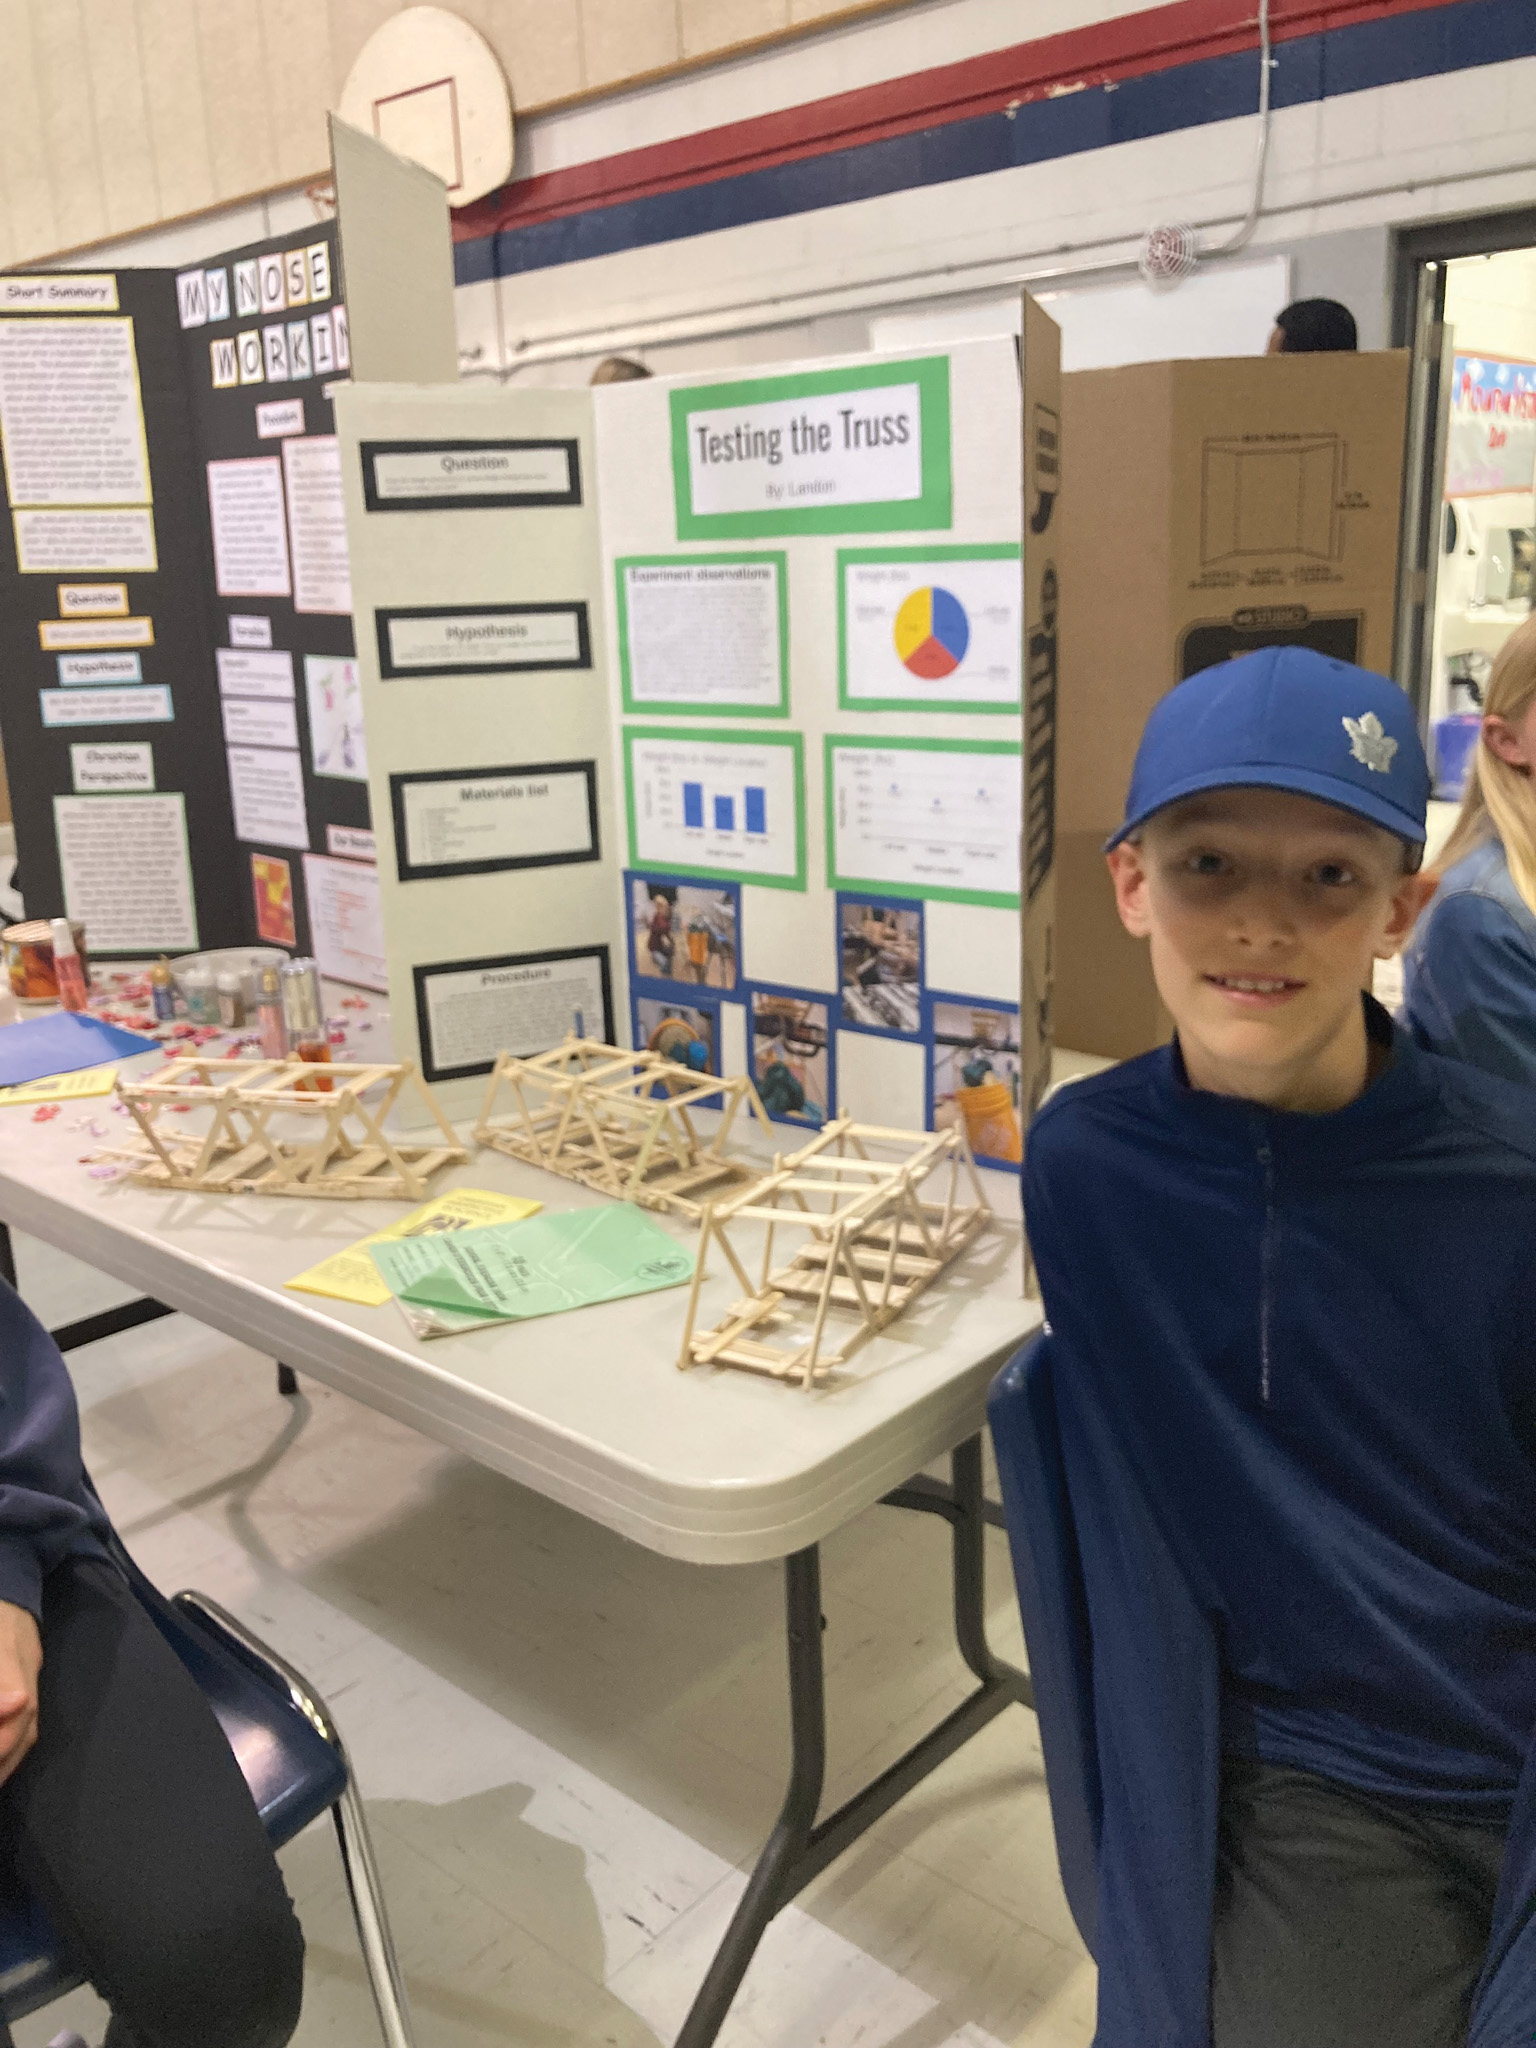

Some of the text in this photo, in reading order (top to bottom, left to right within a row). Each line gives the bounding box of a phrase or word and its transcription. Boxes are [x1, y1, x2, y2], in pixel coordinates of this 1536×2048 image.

[183, 251, 326, 320] MY NOSE
[696, 407, 911, 466] Testing the Truss
[440, 455, 509, 474] Question
[445, 623, 529, 642] Hypothesis
[480, 966, 552, 987] Procedure
